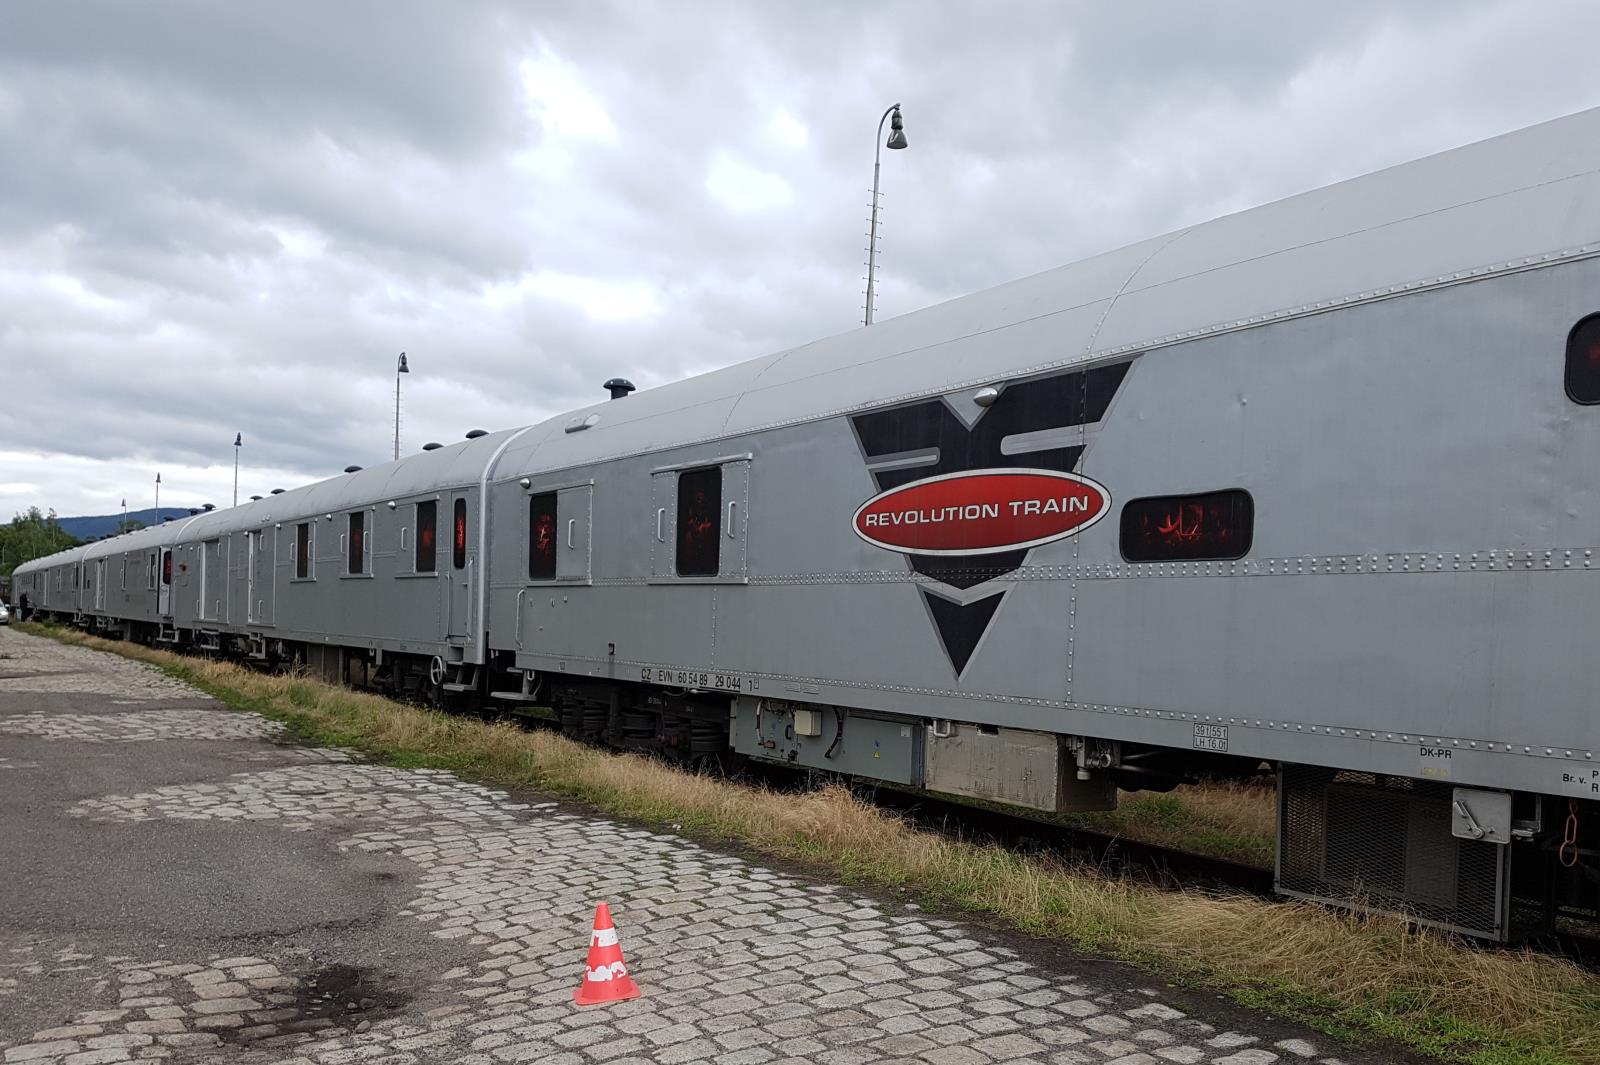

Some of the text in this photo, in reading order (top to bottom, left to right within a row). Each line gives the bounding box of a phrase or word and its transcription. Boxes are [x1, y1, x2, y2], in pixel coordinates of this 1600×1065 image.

[865, 495, 1089, 527] REVOLUTION TRAIN
[641, 668, 651, 680] CZ
[658, 670, 673, 682] EVN
[678, 672, 687, 683] 60
[689, 672, 698, 685] 54
[699, 674, 708, 686] 89
[715, 675, 724, 687] 29
[726, 676, 741, 689] 044
[1195, 725, 1205, 735] 39
[1212, 727, 1221, 737] 55
[1196, 738, 1205, 747] LH
[1420, 747, 1452, 759] DK-PR
[1562, 773, 1587, 784] Br. v.
[1592, 770, 1599, 779] P
[1591, 783, 1599, 792] R
